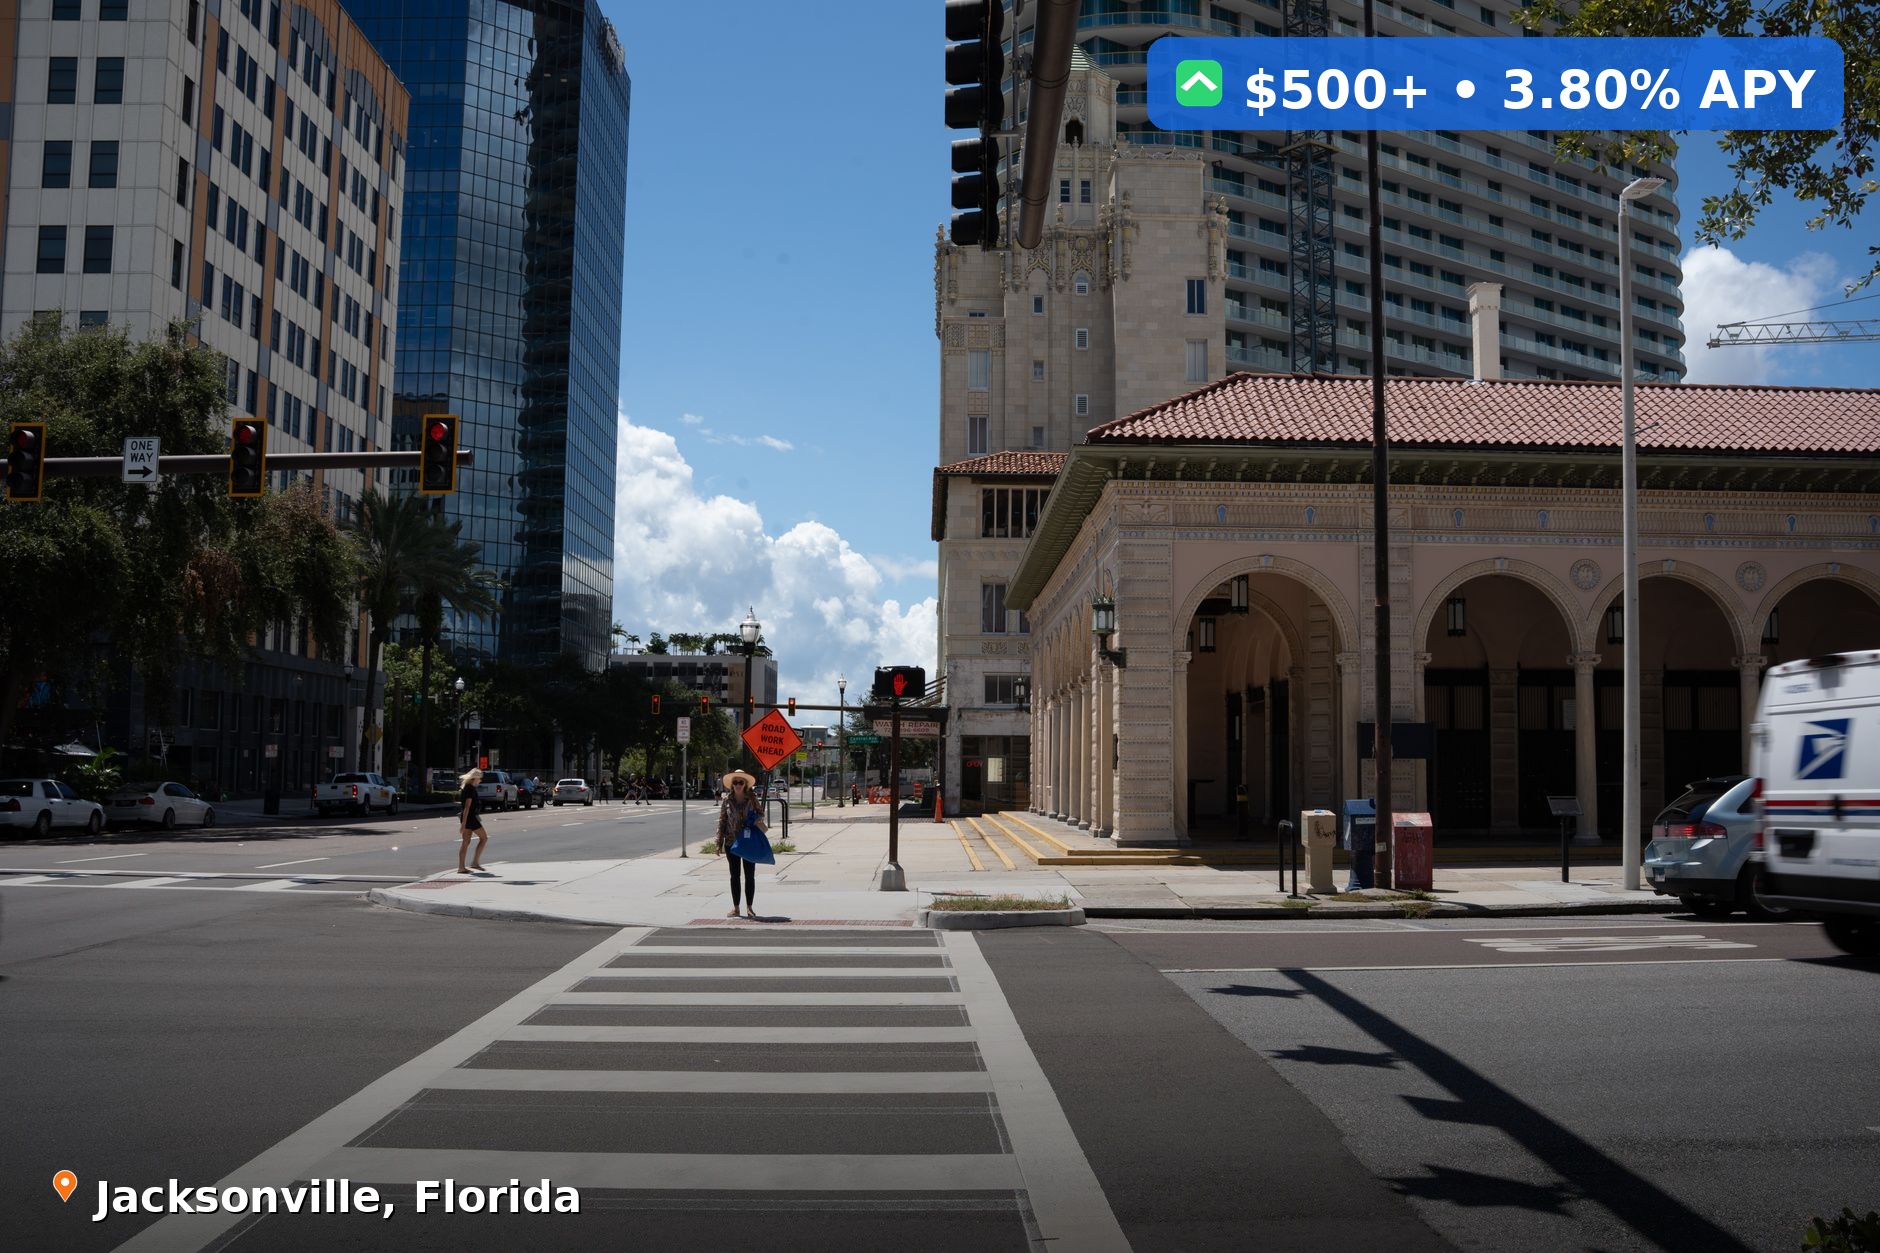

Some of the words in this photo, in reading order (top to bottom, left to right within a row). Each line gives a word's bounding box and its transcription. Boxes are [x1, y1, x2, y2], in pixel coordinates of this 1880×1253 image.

[131, 440, 153, 451] ONE
[131, 452, 153, 463] WAY
[761, 723, 786, 734] ROAD
[908, 721, 938, 729] REPAIR
[760, 734, 784, 745] WORK
[757, 746, 785, 757] AHEAD
